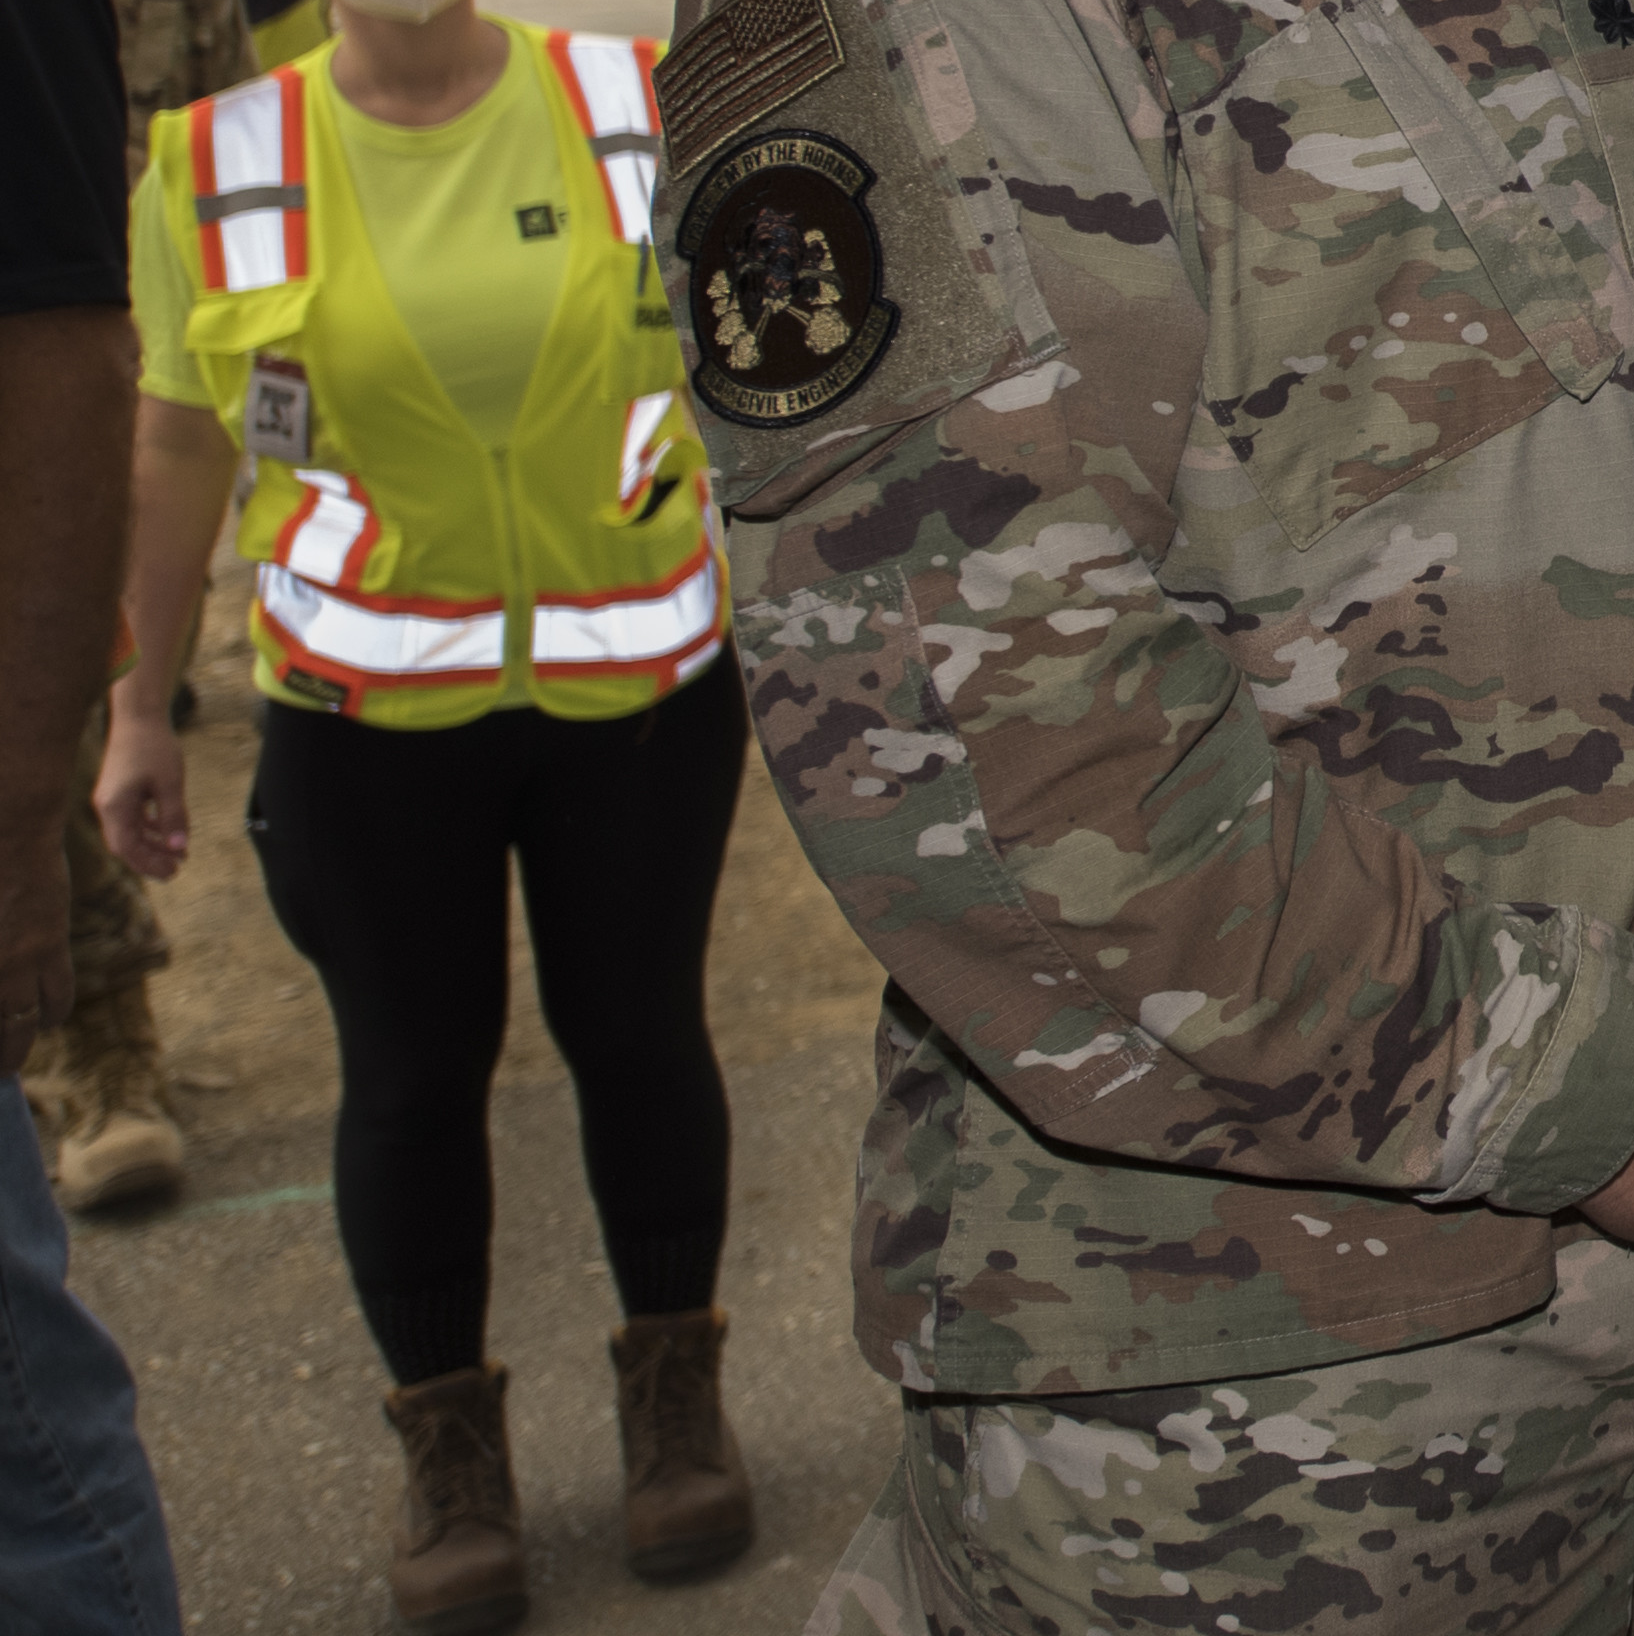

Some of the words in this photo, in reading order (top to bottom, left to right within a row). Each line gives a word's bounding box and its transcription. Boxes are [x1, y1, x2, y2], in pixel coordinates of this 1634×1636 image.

[743, 150, 762, 172] BY
[767, 142, 797, 162] THE
[803, 144, 858, 187] HORNS
[737, 390, 780, 413] CIVIL
[787, 346, 866, 411] ENGINEER
